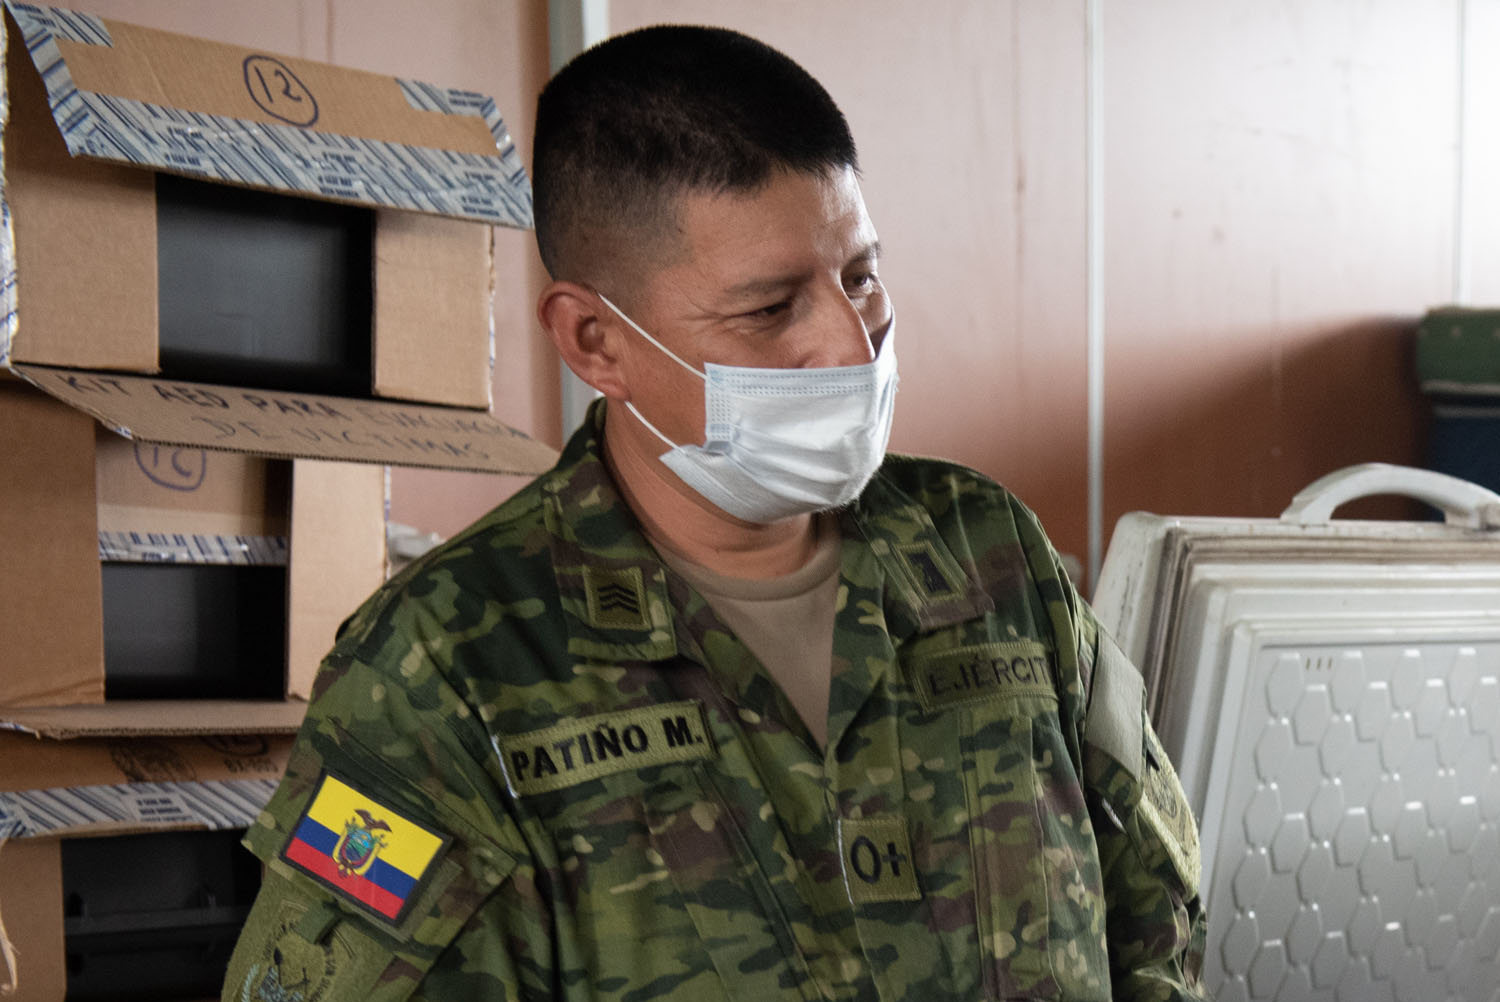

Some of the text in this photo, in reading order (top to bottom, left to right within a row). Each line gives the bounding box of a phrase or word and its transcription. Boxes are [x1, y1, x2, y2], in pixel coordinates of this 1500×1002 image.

[67, 375, 131, 397] KIT
[510, 715, 704, 782] PATIÑO M.
[850, 835, 907, 884] O+
